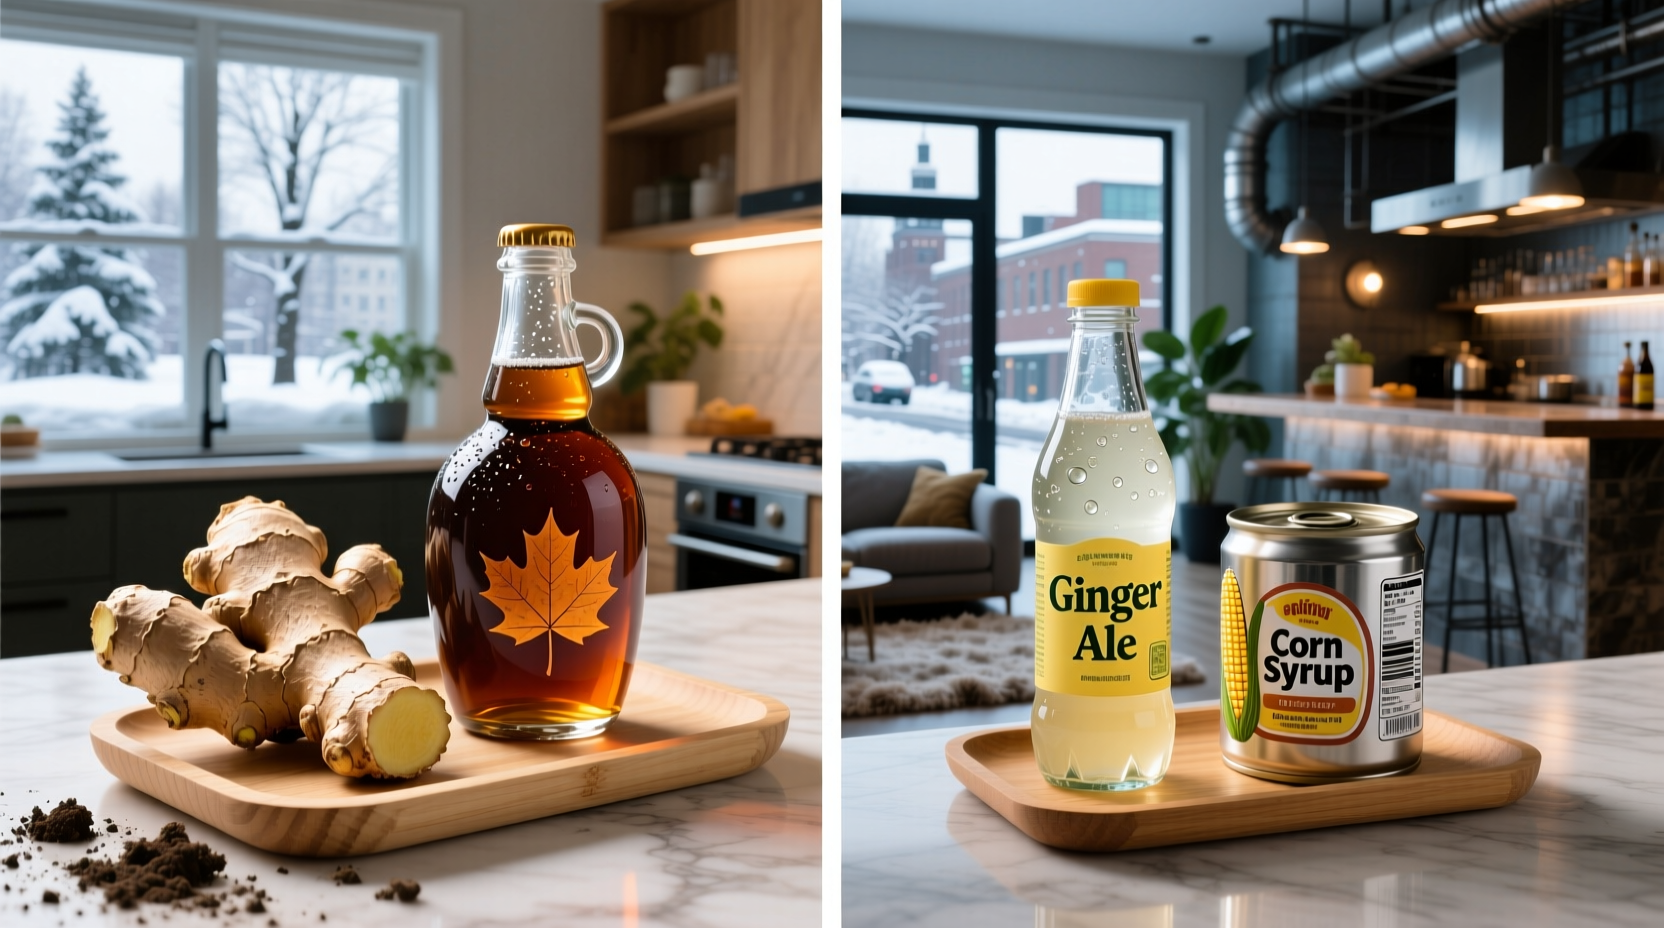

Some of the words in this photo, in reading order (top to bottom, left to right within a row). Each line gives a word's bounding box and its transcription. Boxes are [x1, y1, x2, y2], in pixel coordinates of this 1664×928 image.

[1050, 575, 1162, 623] Ginger
[1073, 624, 1137, 661] Ale
[1271, 628, 1343, 659] Corn
[1264, 655, 1354, 693] Syrup
